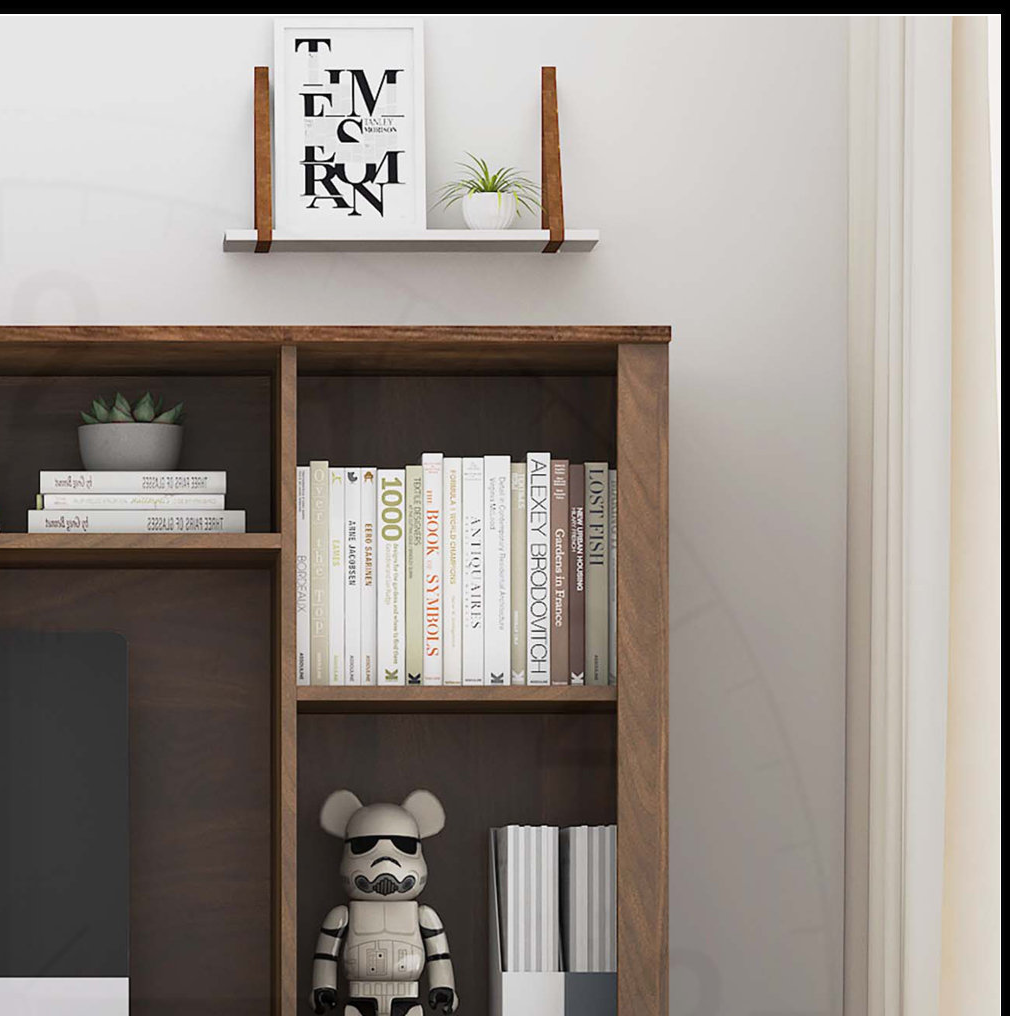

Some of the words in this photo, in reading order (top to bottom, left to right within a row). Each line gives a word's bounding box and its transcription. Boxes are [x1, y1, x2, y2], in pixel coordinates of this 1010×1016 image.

[381, 477, 403, 541] 1000
[413, 477, 421, 505] TEXTILE
[530, 459, 547, 537] ALEXEY
[589, 469, 604, 519] LOST
[348, 520, 356, 541] ARNE
[413, 506, 422, 546] DESIGNERS
[426, 509, 439, 556] BOOK
[589, 524, 604, 566] FISH
[348, 544, 356, 586] JACOBSEN
[468, 516, 482, 629] ANTIQUAIRES
[554, 528, 566, 574] Gardens
[297, 555, 307, 613] BORDEAUX
[554, 576, 565, 587] in
[426, 574, 439, 657] SYMBOLS
[530, 543, 547, 674] BRODOVITCH
[554, 590, 565, 627] France
